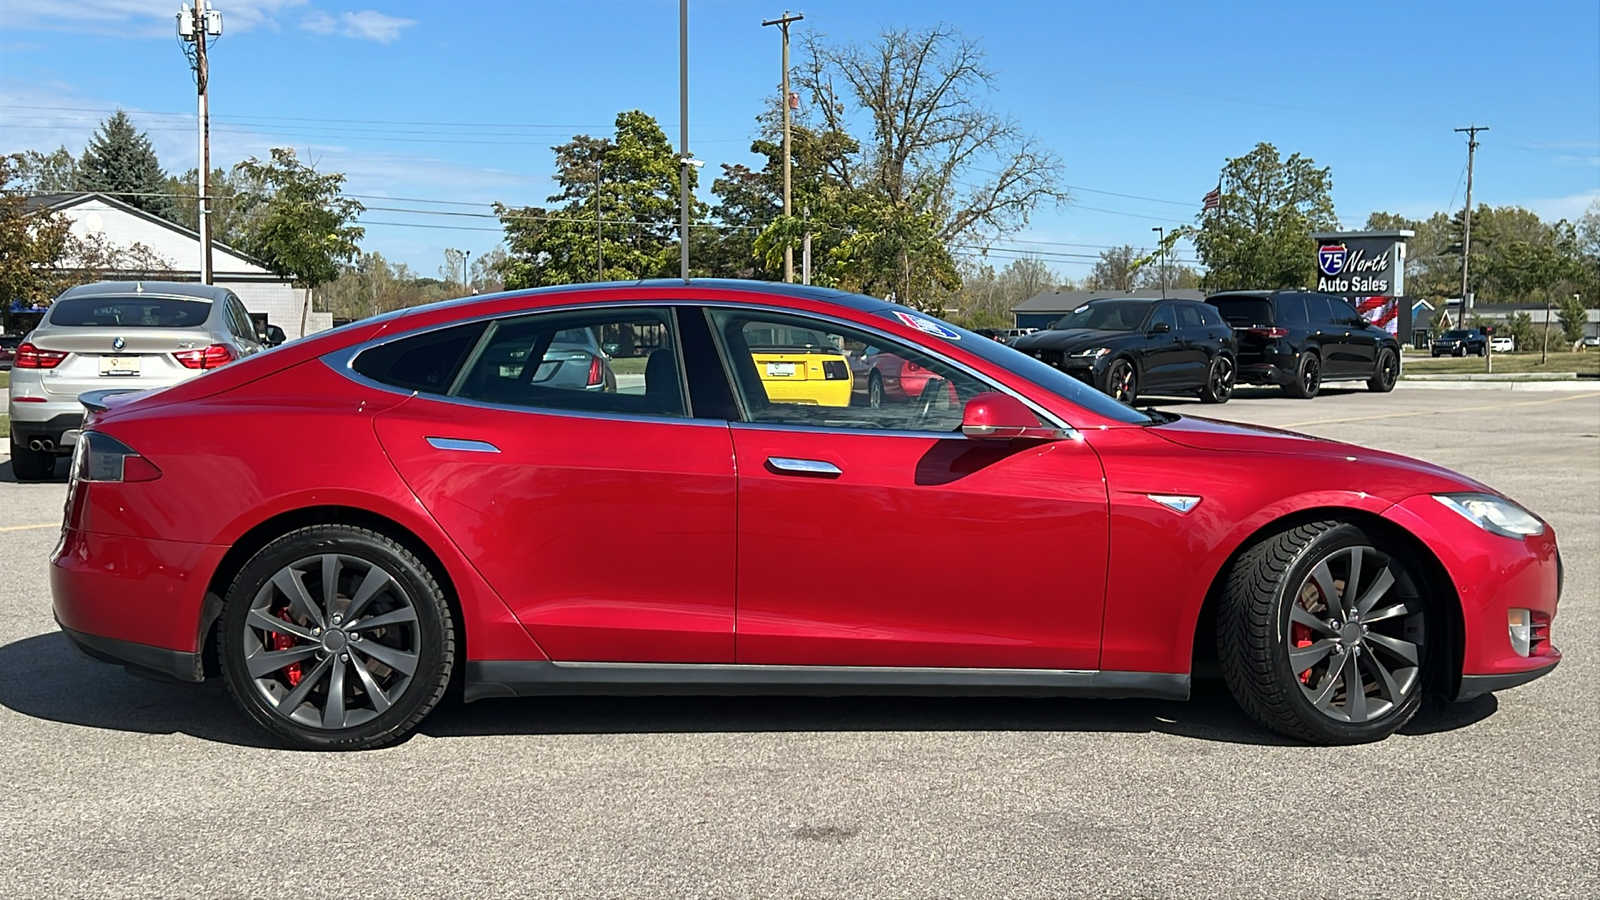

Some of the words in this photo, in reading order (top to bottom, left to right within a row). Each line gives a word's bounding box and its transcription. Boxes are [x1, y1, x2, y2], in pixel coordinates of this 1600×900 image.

[1324, 253, 1343, 268] 75
[1343, 249, 1389, 273] North
[1317, 276, 1349, 292] Auto
[1351, 275, 1388, 292] Sales
